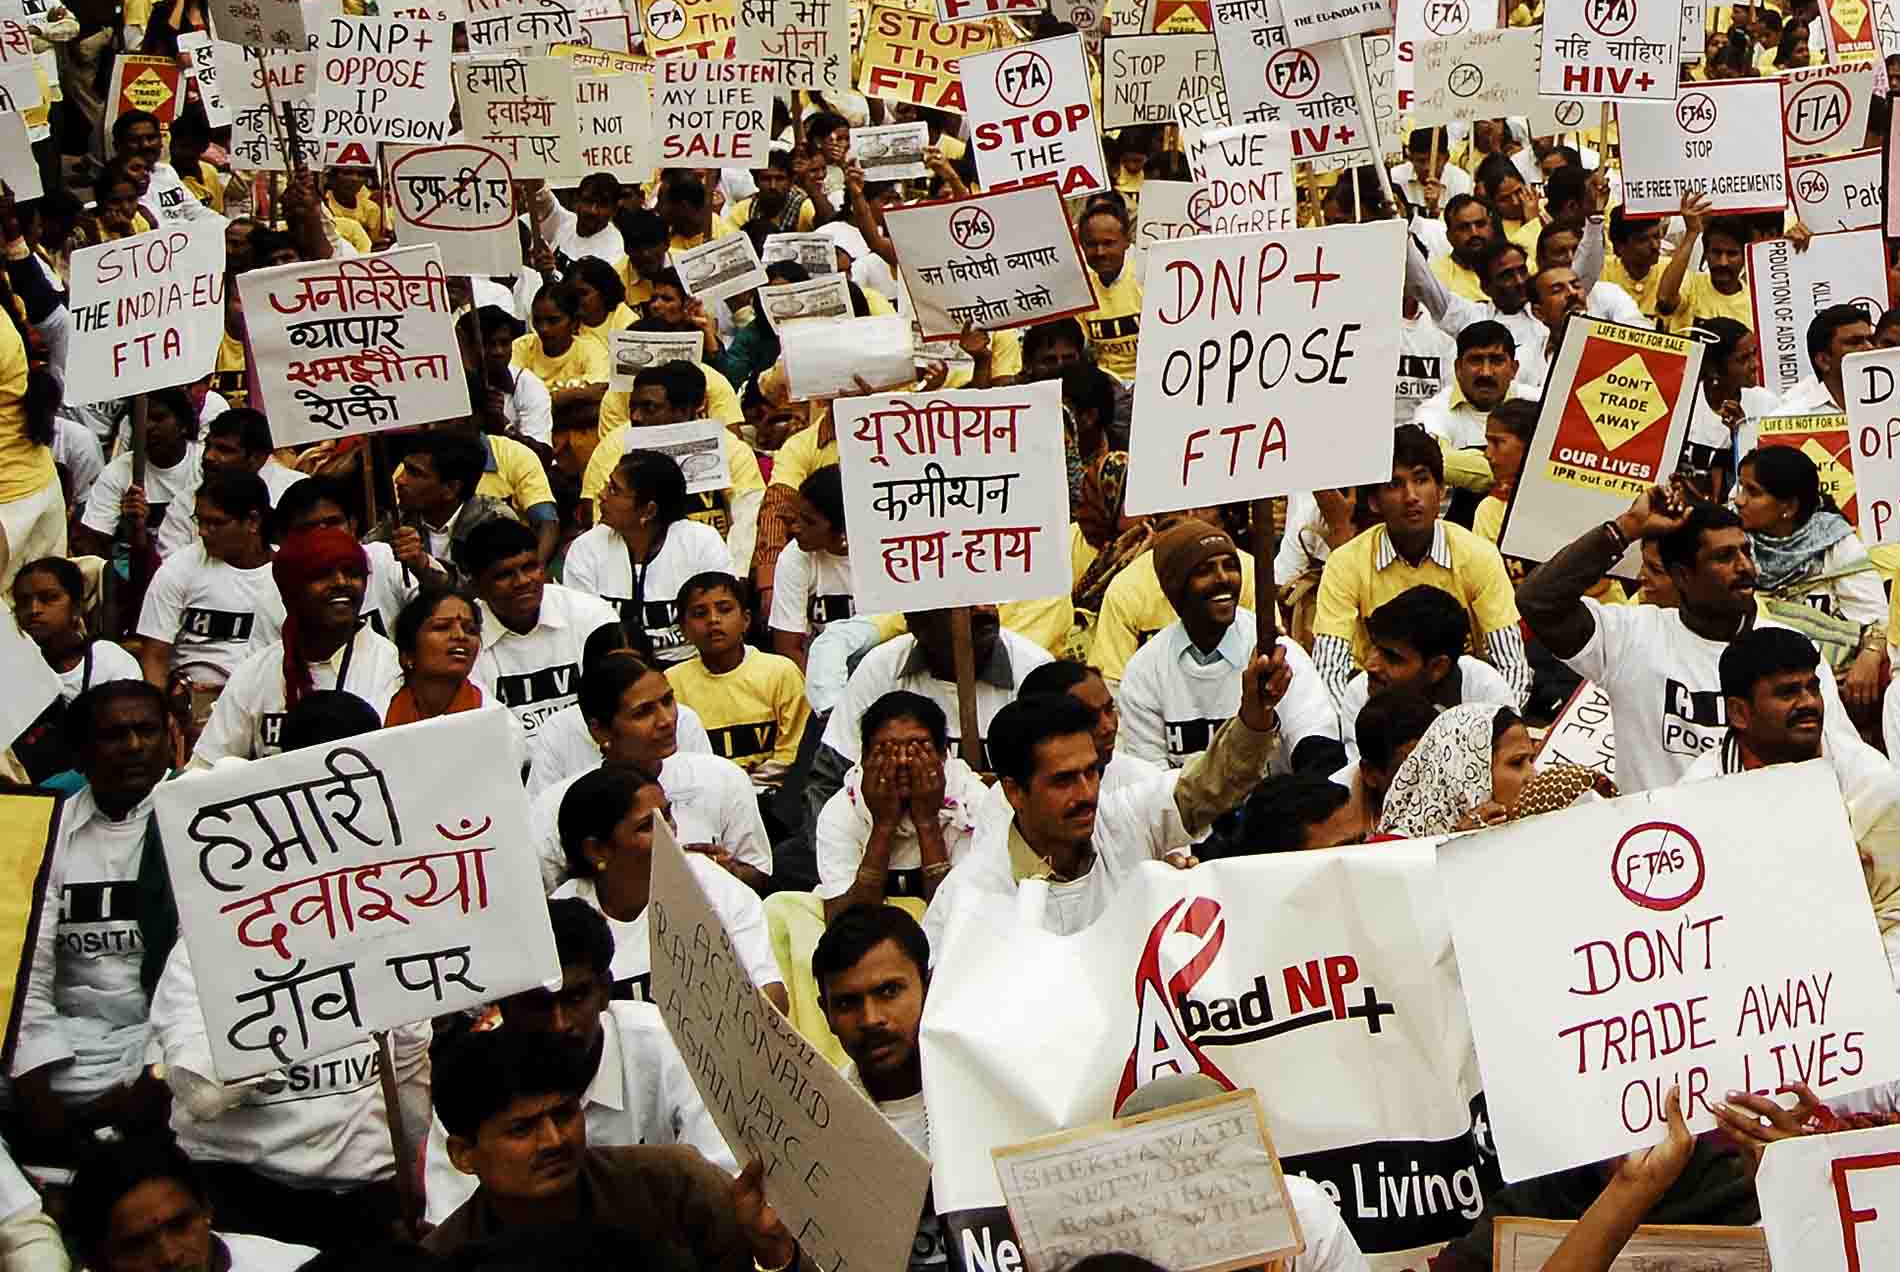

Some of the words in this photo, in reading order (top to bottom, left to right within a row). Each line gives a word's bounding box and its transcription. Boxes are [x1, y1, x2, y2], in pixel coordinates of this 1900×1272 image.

[650, 10, 683, 27] FTA
[1431, 2, 1463, 24] FTA
[878, 11, 986, 50] STOP
[326, 58, 426, 89] OPPOSE
[665, 63, 697, 84] EU
[706, 63, 774, 82] LISTEN
[1112, 49, 1166, 78] STOP
[1274, 58, 1314, 86] FTA
[867, 66, 968, 113] FTA
[1002, 64, 1046, 94] FTA
[1114, 81, 1151, 104] NOT
[1178, 77, 1222, 99] AIDS
[1563, 65, 1655, 95] HIV+
[356, 89, 388, 114] IP
[663, 88, 696, 106] MY
[707, 87, 754, 105] LIFE
[323, 109, 445, 141] PROVISION
[669, 111, 710, 130] NOT
[722, 110, 765, 130] FOR
[975, 103, 1090, 151] STOP
[1681, 106, 1712, 121] FTAs
[1797, 95, 1842, 134] FTA
[663, 134, 752, 159] SALE
[1010, 143, 1066, 172] THE
[1220, 134, 1267, 167] WE
[1685, 140, 1712, 159] STOP
[1210, 171, 1283, 209] DONT
[1626, 181, 1645, 199] THE
[1646, 179, 1672, 198] FREE
[1674, 177, 1707, 196] TRADE
[1712, 173, 1782, 194] AGREEMENTS
[1800, 179, 1826, 195] FTAs
[955, 219, 990, 242] FTAs
[96, 232, 189, 285] STOP
[1006, 244, 1060, 271] व्यापार
[1014, 284, 1052, 309] रोको
[71, 302, 109, 333] THE
[286, 314, 405, 350] व्यापार
[1597, 325, 1616, 337] LIFE
[112, 328, 181, 379] FTA
[1160, 323, 1362, 406] OPPOSE
[1607, 373, 1653, 390] DON'T
[1599, 392, 1649, 413] TRADE
[1595, 412, 1640, 433] AWAY
[1182, 416, 1288, 488] FTA
[1558, 446, 1599, 470] OUR
[1601, 454, 1651, 480] LIVES
[1552, 465, 1577, 481] IPR
[1580, 473, 1601, 486] out
[1604, 476, 1618, 490] of
[1619, 481, 1644, 494] FTA
[187, 746, 402, 892] हमारी
[1624, 845, 1686, 891] FTAS
[1567, 913, 1725, 998] DON'T
[385, 945, 486, 1001] पर
[1559, 995, 1718, 1076] TRADE
[1735, 971, 1833, 1039] AWAY
[1744, 1031, 1865, 1098] LIVES
[1353, 1159, 1484, 1220] Living
